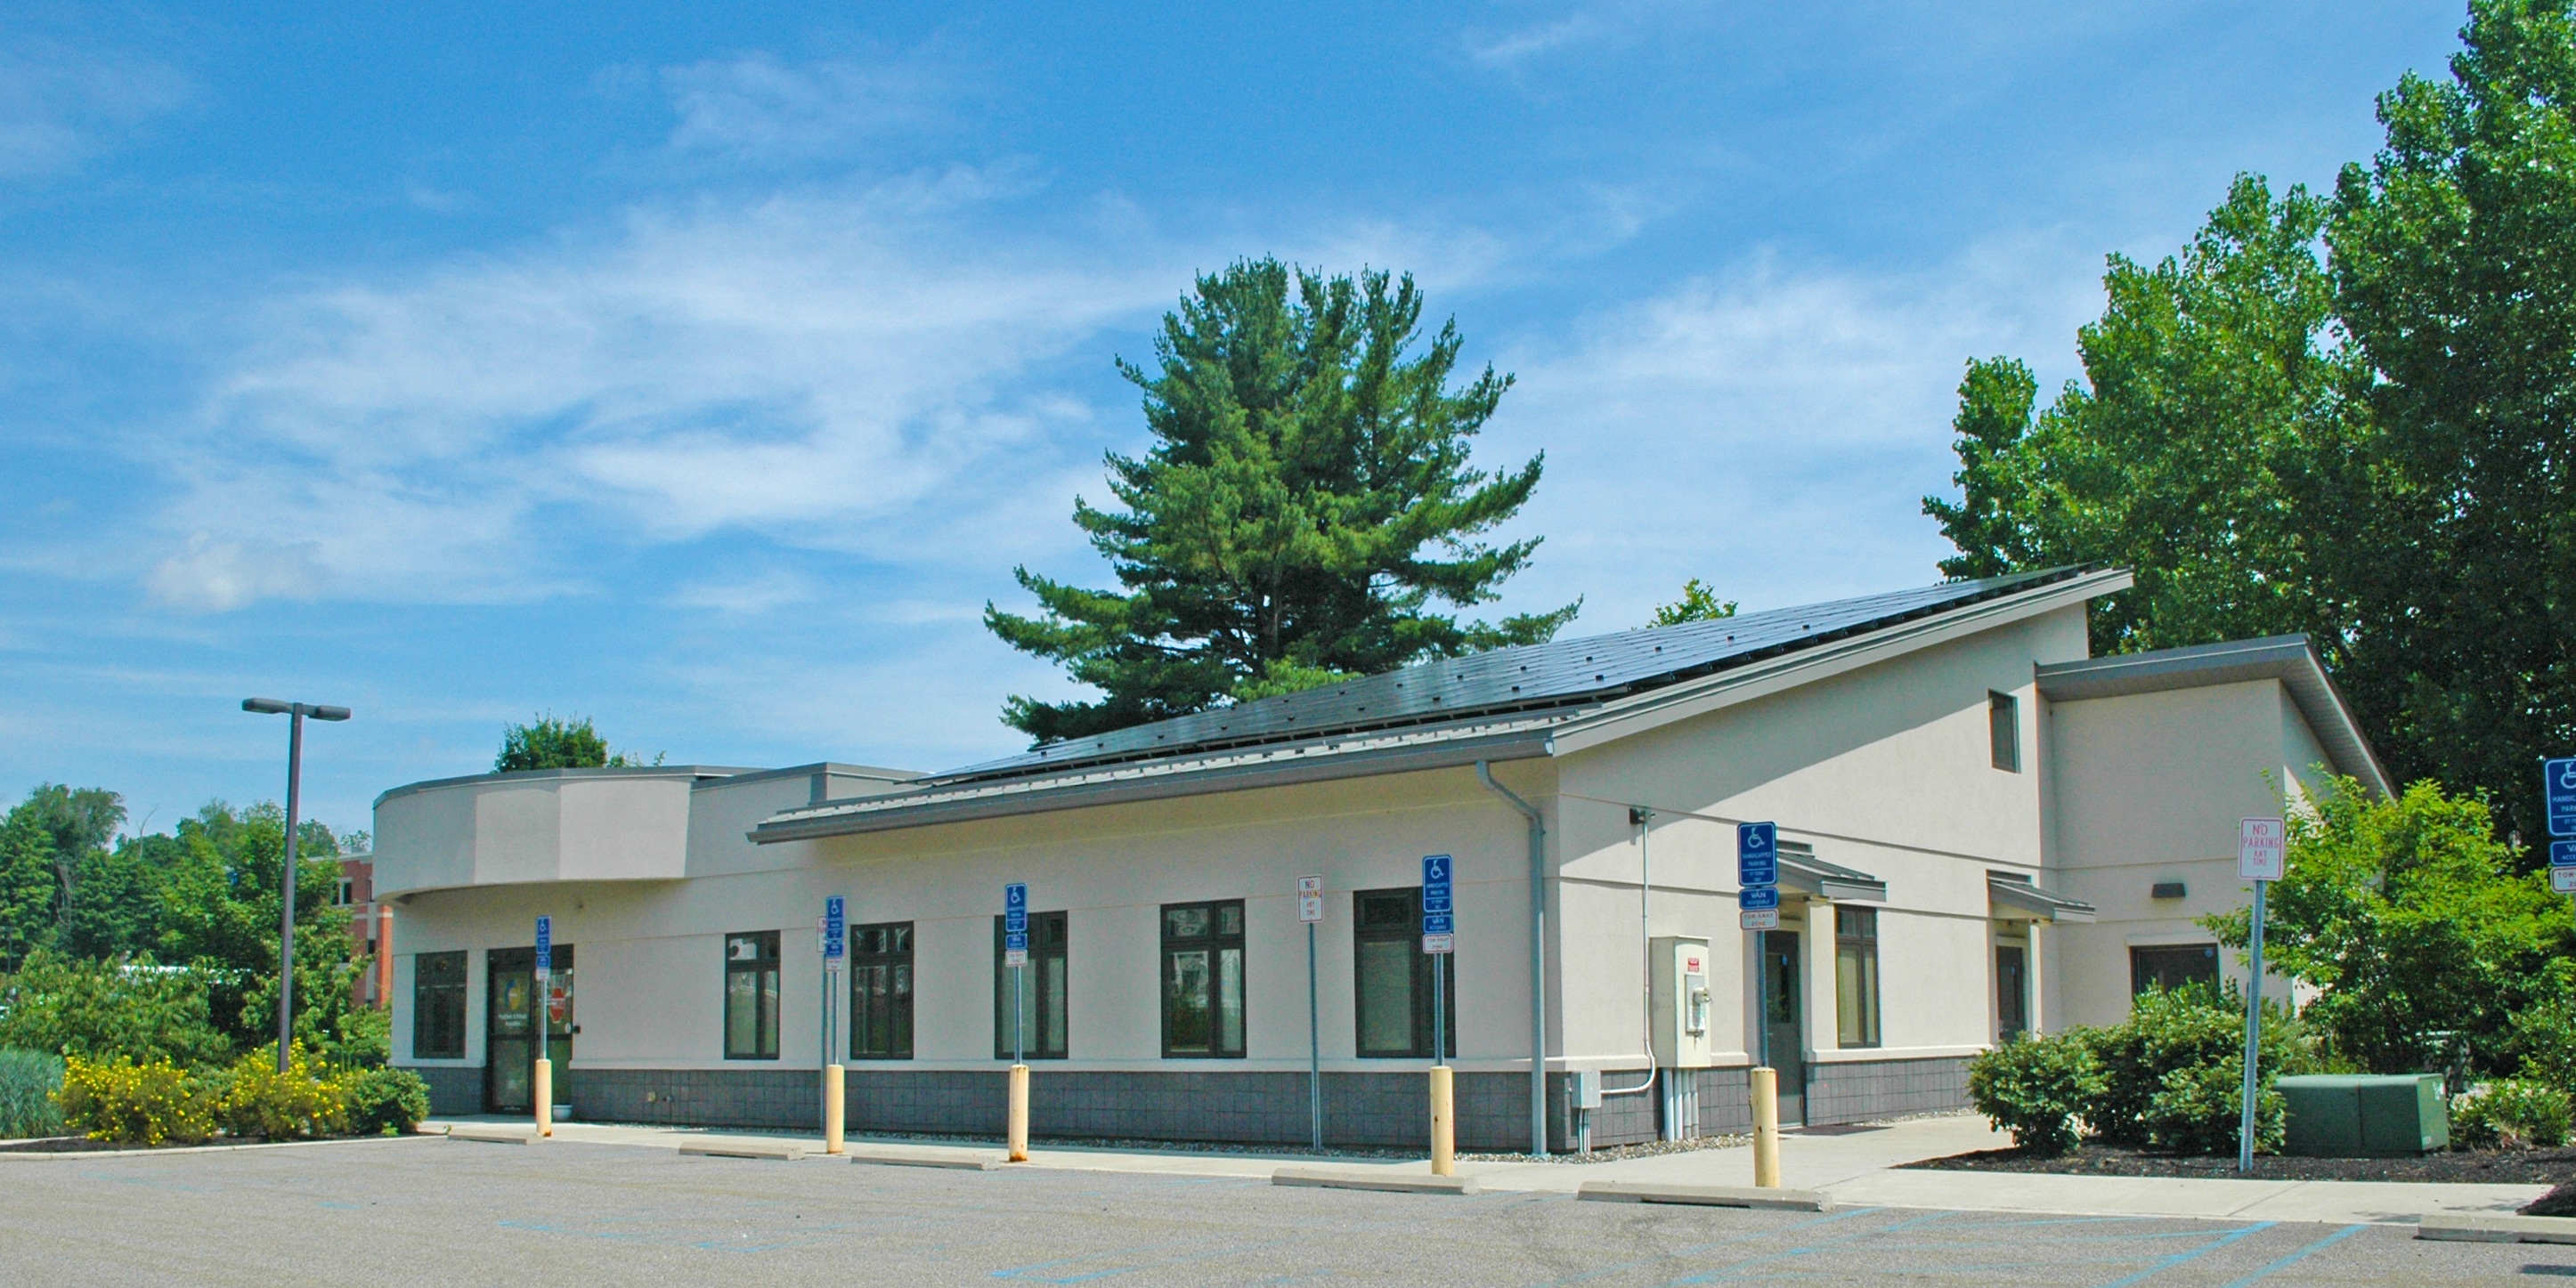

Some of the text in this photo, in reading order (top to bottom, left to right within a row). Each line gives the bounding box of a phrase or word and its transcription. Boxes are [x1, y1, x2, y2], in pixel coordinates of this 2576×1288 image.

[2252, 824, 2268, 836] NO
[2242, 837, 2279, 848] PARKING
[2253, 858, 2268, 866] TIME
[1305, 880, 1314, 889] NO
[1299, 890, 1321, 899] PARKING
